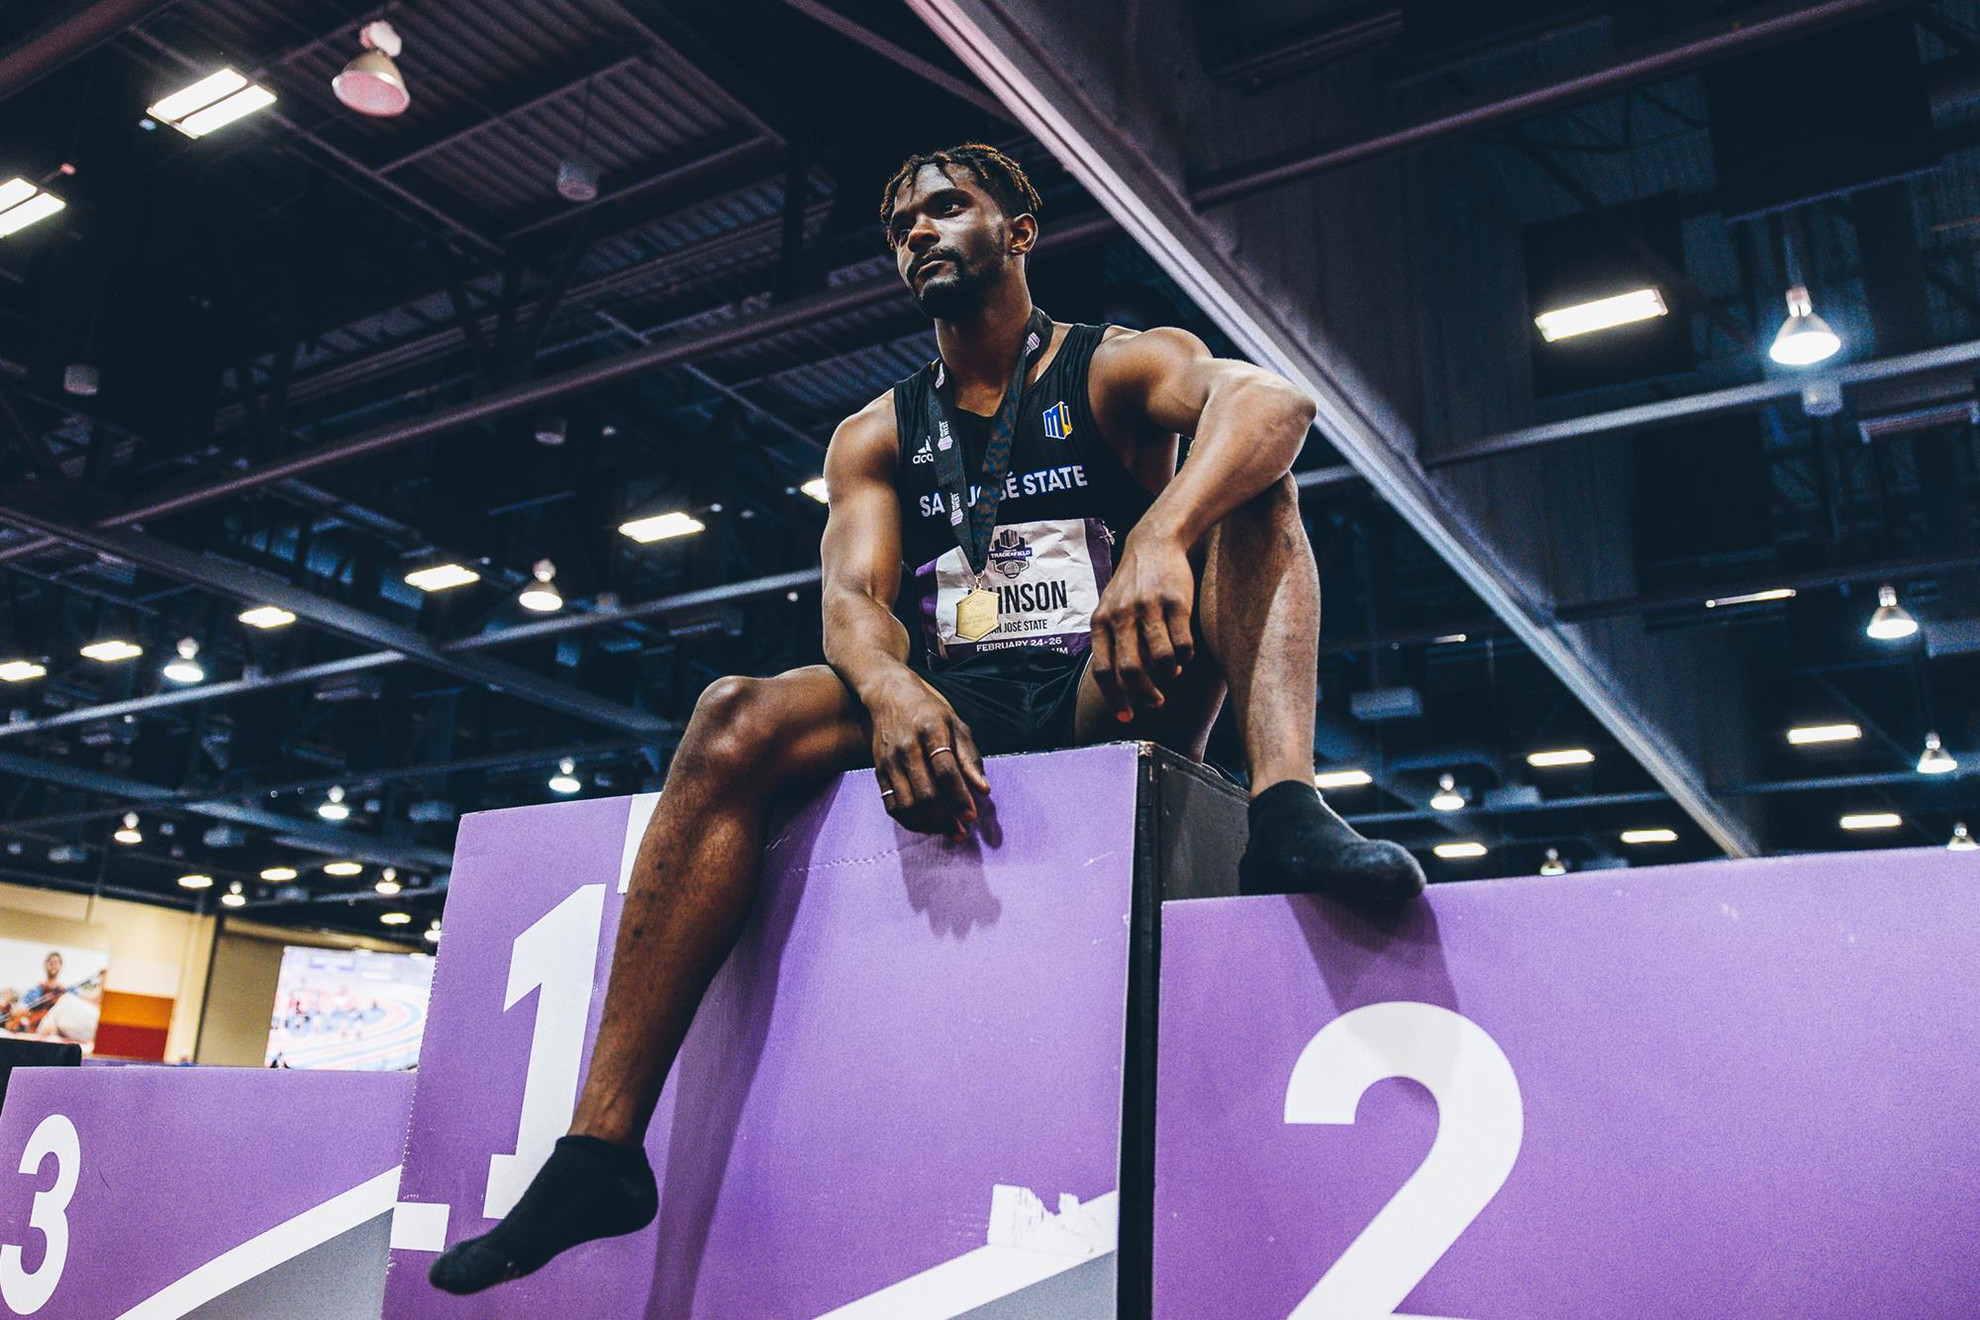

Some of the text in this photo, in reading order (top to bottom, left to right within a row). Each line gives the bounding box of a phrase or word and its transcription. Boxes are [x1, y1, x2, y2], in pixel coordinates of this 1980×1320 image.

[920, 493, 946, 517] SA
[967, 472, 1020, 507] JÉ
[1022, 465, 1088, 496] STATE
[976, 641, 1028, 652] FEBRUARY
[1004, 620, 1022, 633] JOSÉ
[1024, 619, 1047, 631] STATE
[483, 884, 606, 1219] 1
[0, 1114, 81, 1315] 3
[1284, 1001, 1524, 1320] 2
